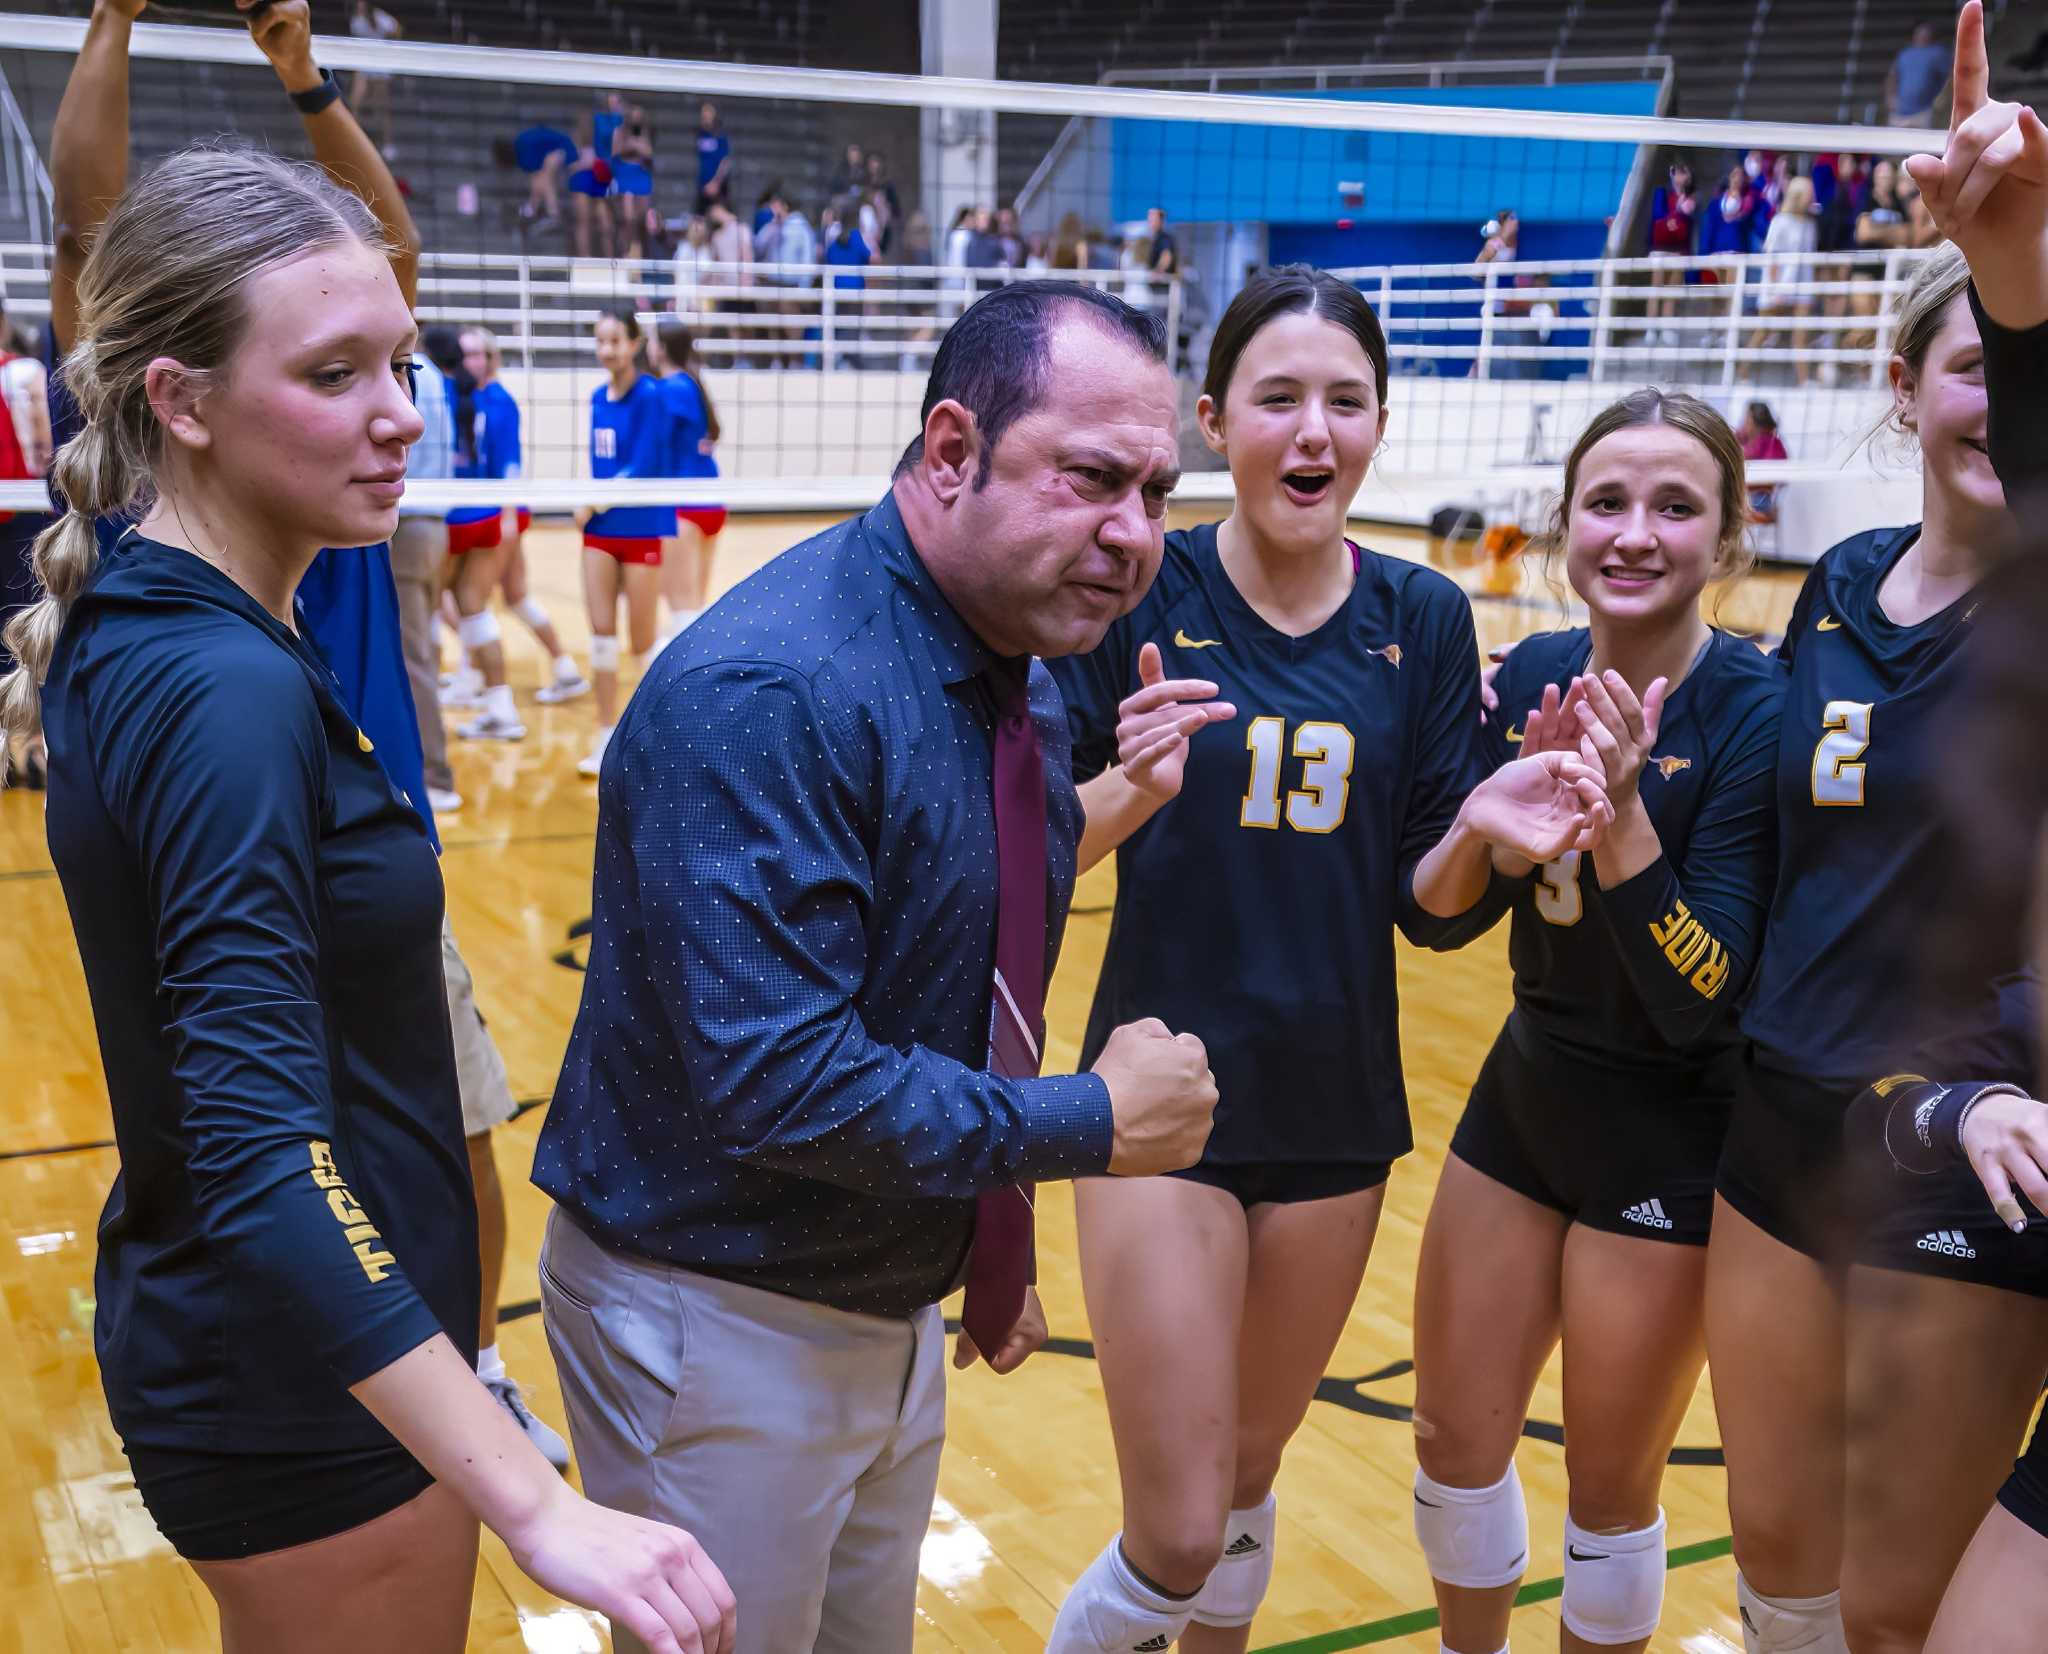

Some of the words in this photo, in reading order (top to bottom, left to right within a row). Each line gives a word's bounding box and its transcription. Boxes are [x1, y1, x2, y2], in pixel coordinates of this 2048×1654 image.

[1241, 716, 1356, 834] 13
[1811, 700, 1875, 807] 2
[1535, 850, 1584, 927] 3
[1648, 899, 1730, 1001] RIDE
[1917, 1239, 1977, 1259] adidas
